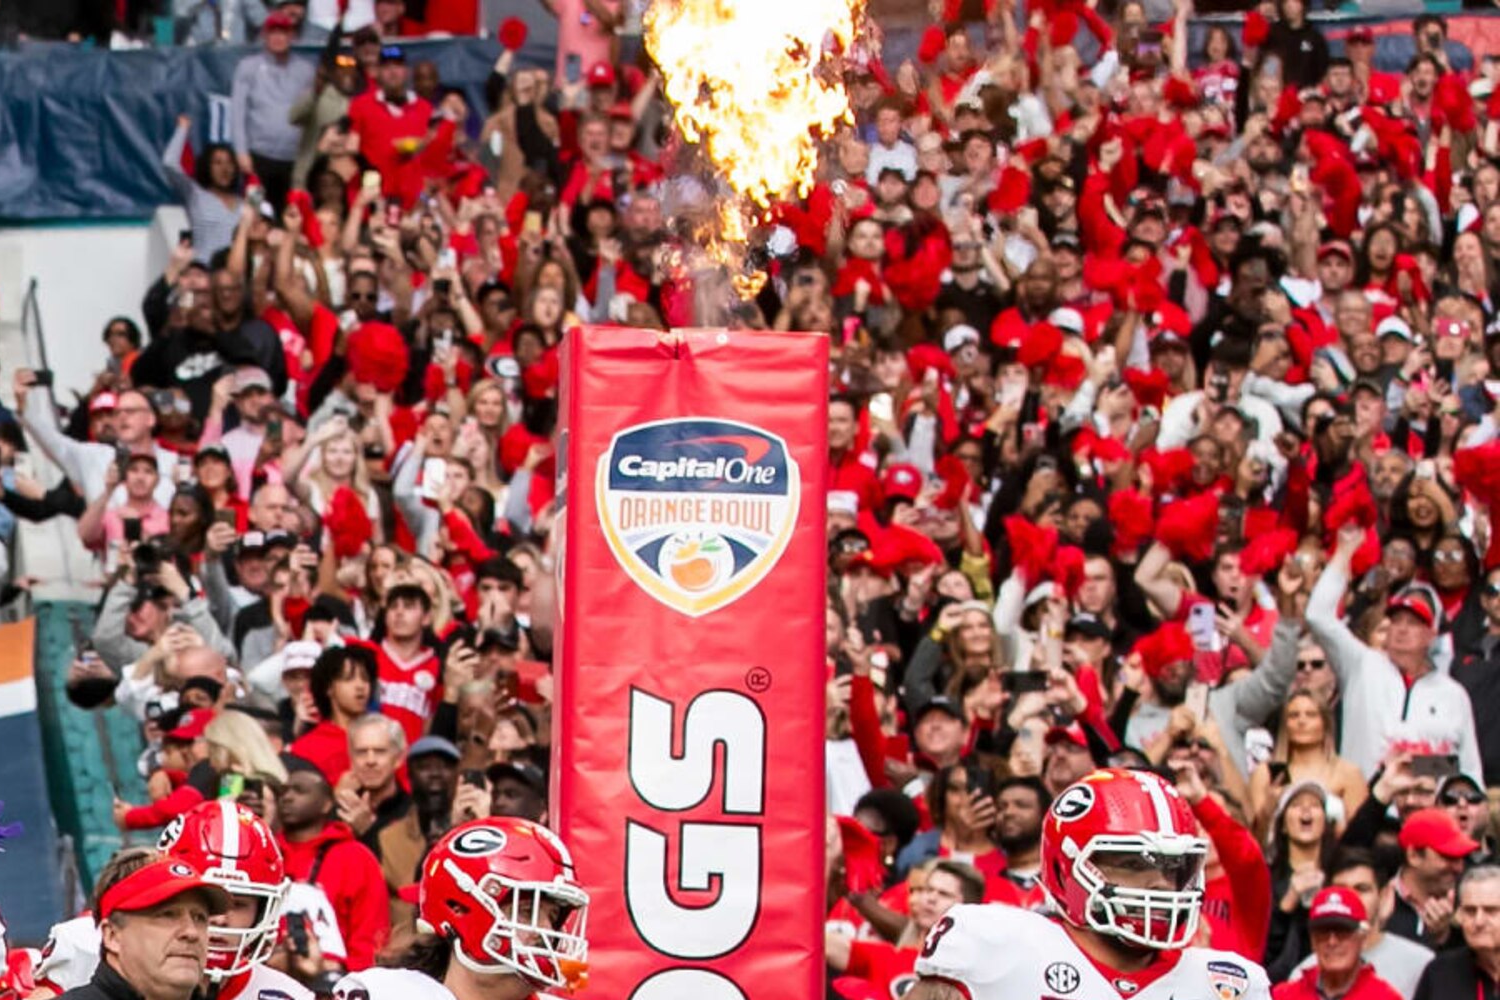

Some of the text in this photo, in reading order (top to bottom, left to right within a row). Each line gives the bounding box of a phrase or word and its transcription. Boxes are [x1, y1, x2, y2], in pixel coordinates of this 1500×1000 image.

[619, 496, 775, 536] ORANGE BOWL
[1046, 962, 1080, 993] SEC
